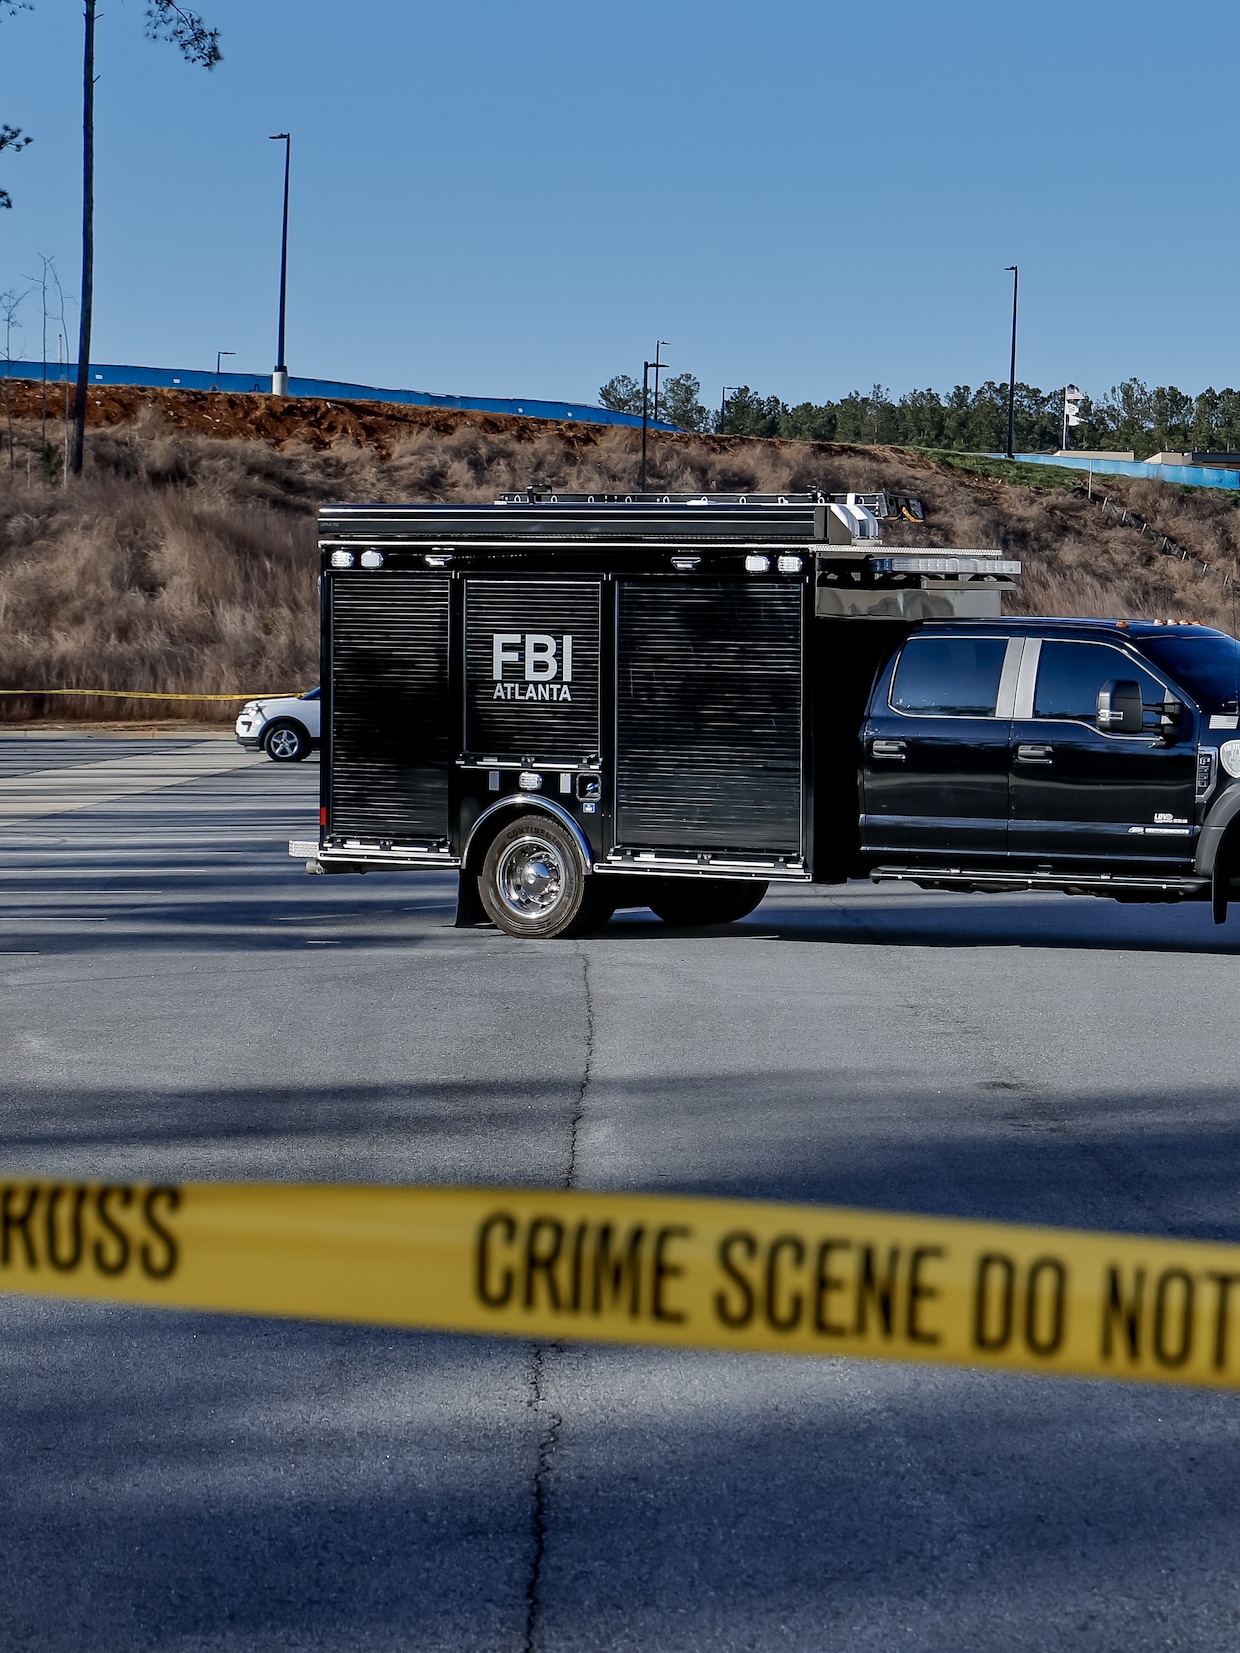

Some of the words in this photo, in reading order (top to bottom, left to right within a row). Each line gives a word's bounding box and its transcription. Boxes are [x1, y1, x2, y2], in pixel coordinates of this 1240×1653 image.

[493, 634, 572, 681] FBI
[493, 683, 572, 701] ATLANTA
[475, 1211, 694, 1328] CRIME
[711, 1230, 948, 1346] SCENE
[971, 1251, 1067, 1358] DO
